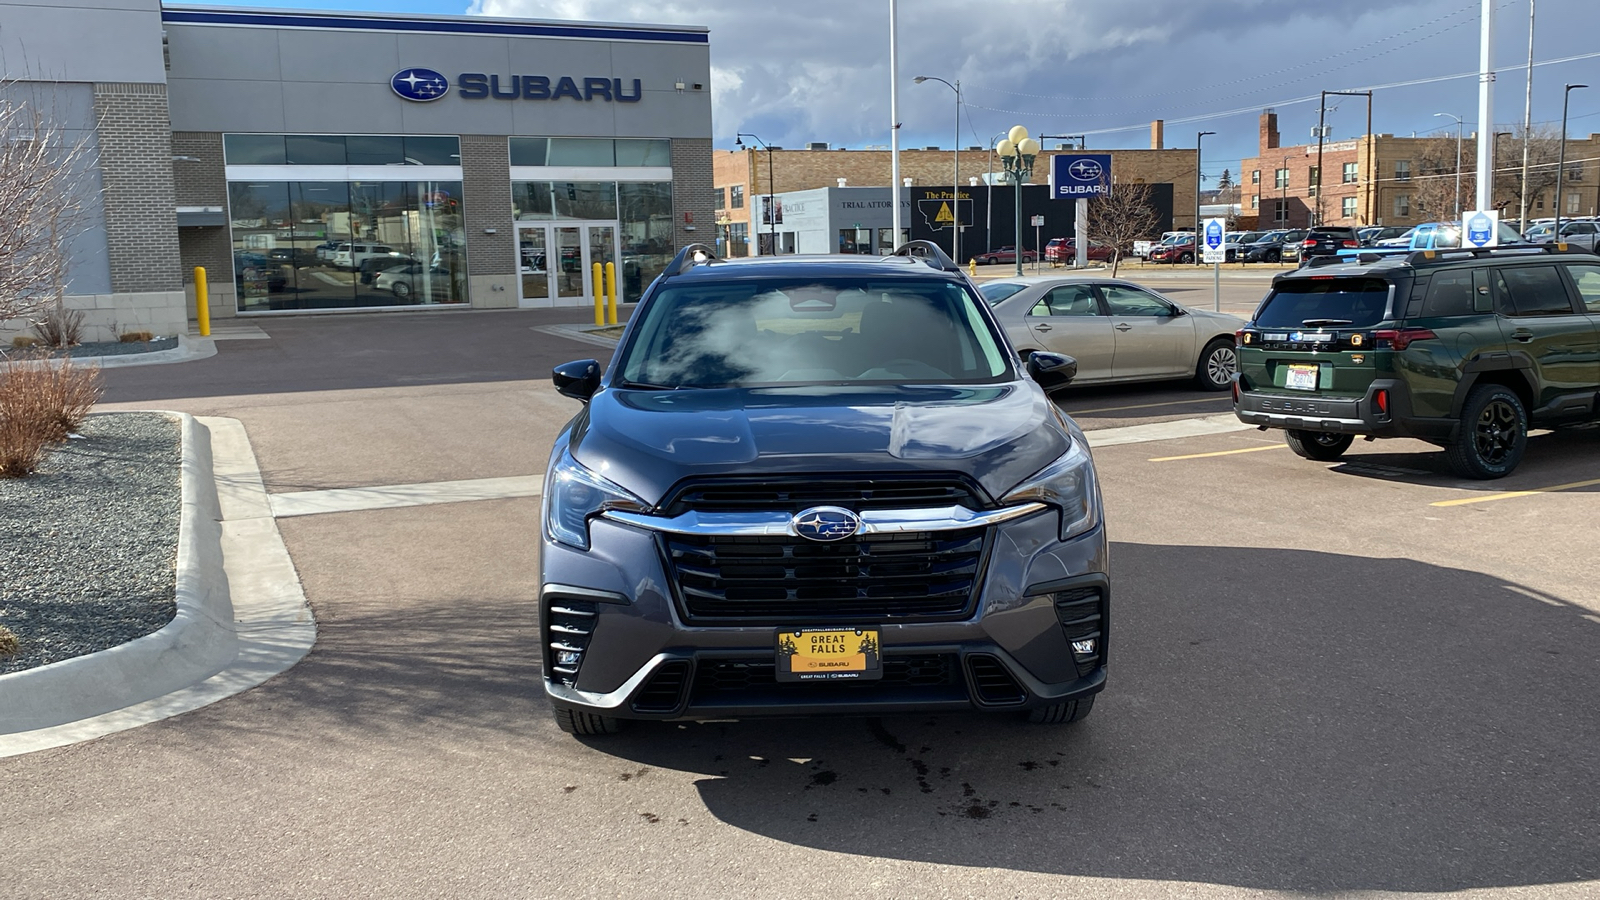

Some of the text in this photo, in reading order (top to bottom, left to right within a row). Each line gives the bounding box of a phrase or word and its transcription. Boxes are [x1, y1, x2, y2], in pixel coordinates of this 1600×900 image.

[458, 73, 642, 103] SUBARU
[1060, 185, 1109, 194] SUBARU
[941, 191, 970, 199] Pratice
[841, 201, 866, 209] TRIAL
[811, 635, 846, 644] GREAT
[811, 644, 846, 653] FALLS
